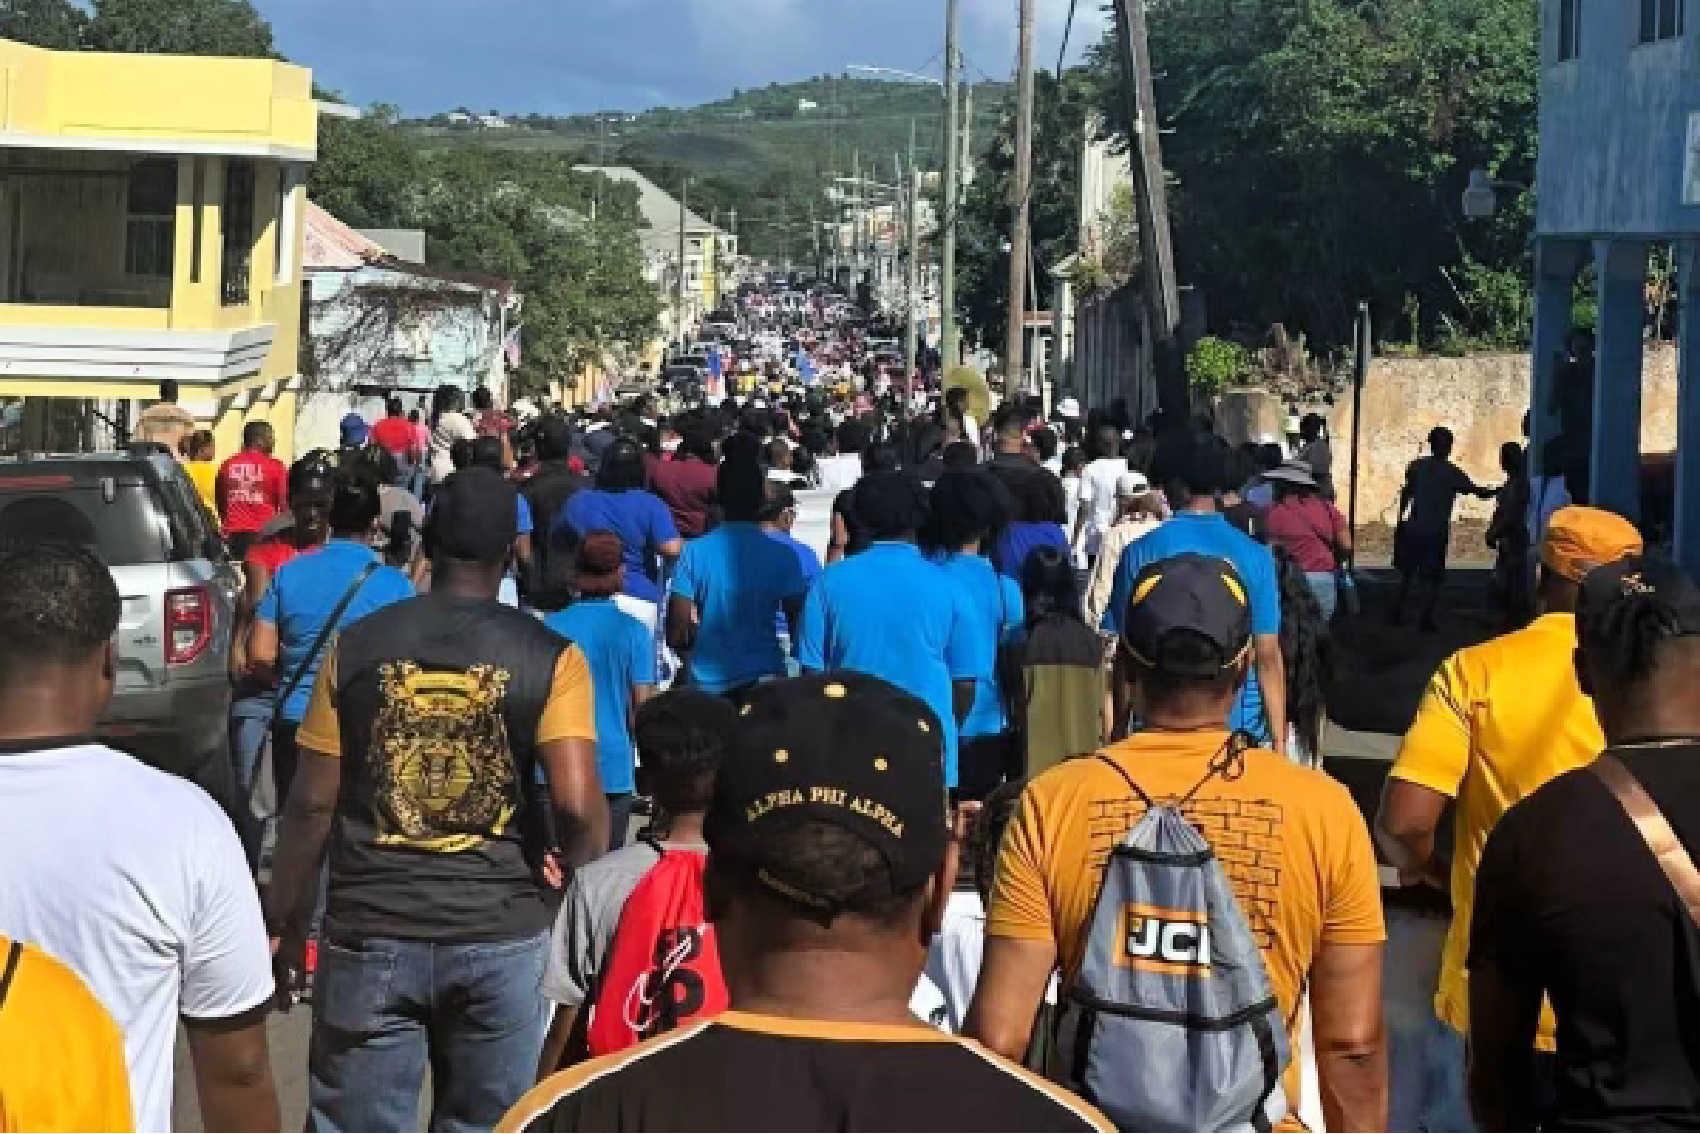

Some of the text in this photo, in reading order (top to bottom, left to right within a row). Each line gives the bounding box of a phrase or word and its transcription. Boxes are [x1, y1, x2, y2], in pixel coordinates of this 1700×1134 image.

[745, 786, 905, 840] ALPHA PHI ALPHA
